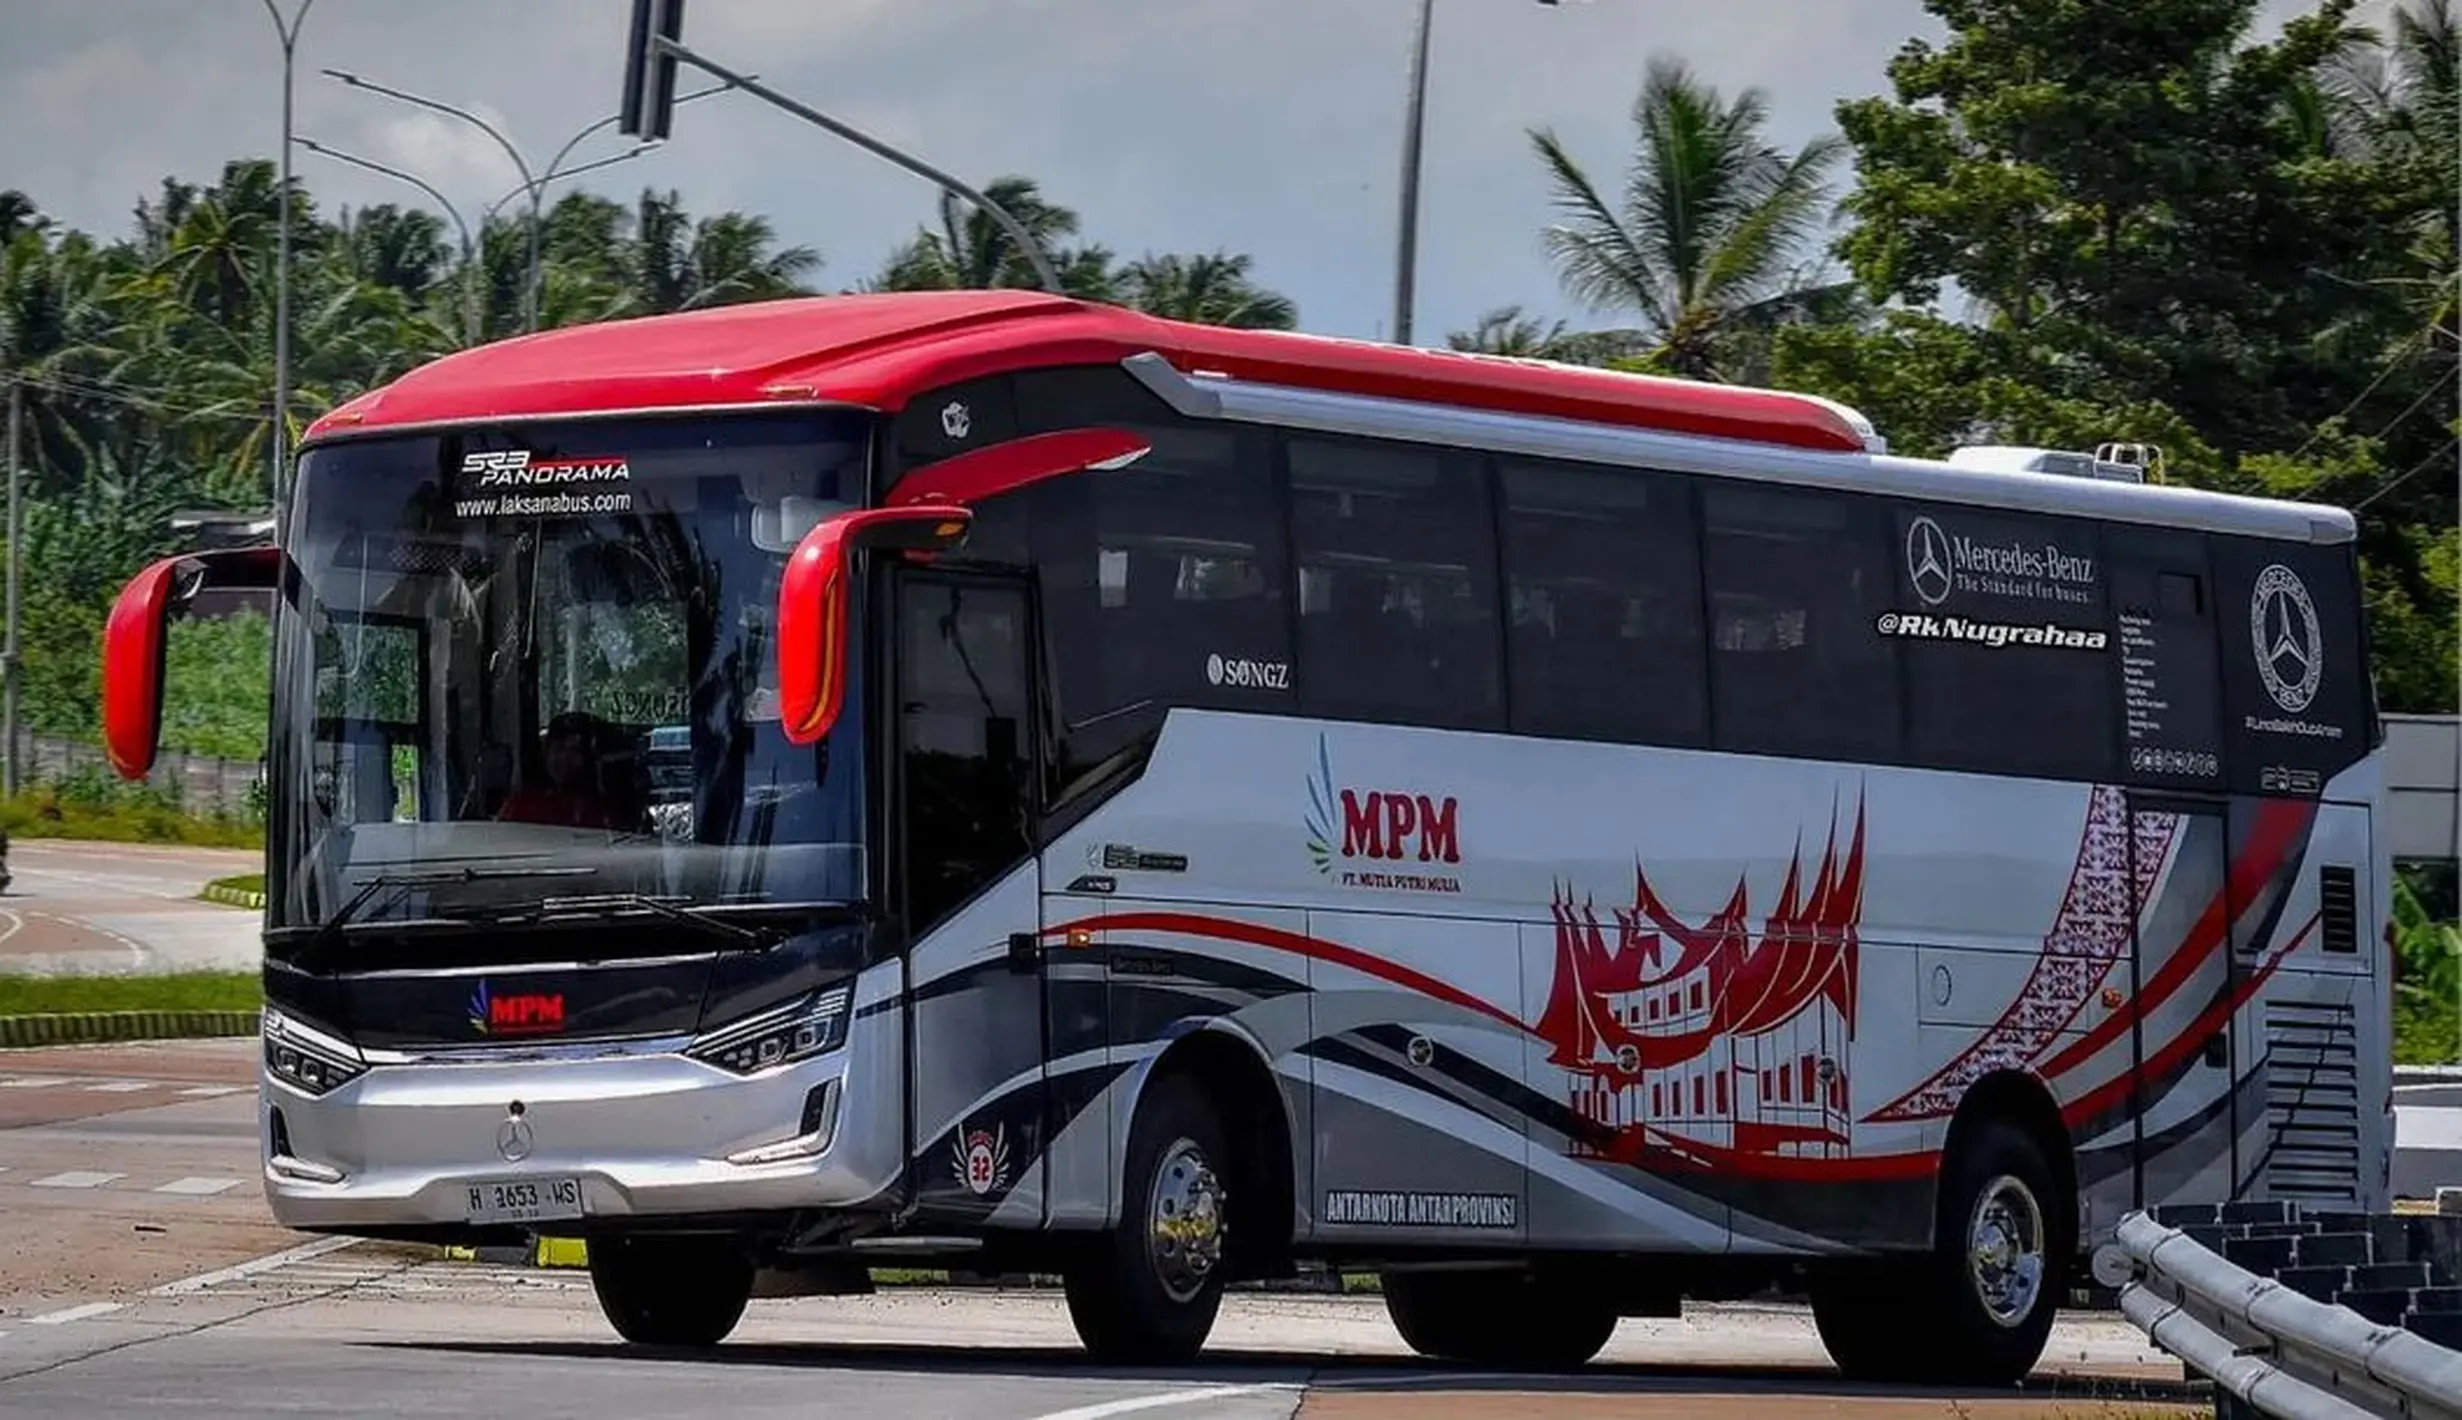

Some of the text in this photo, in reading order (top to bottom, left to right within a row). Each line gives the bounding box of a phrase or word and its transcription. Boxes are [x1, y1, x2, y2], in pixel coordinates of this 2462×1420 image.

[480, 464, 630, 486] PANORAMA
[455, 492, 632, 517] www.laksanabus.com
[1953, 536, 2094, 583] Mercedes-Benz
[1956, 573, 1979, 593] The
[1981, 576, 2034, 598] Standard
[1340, 789, 1460, 864] MPM
[491, 993, 565, 1024] MPM
[973, 1155, 990, 1182] 32
[1326, 1192, 1406, 1223] ANTARKOTA
